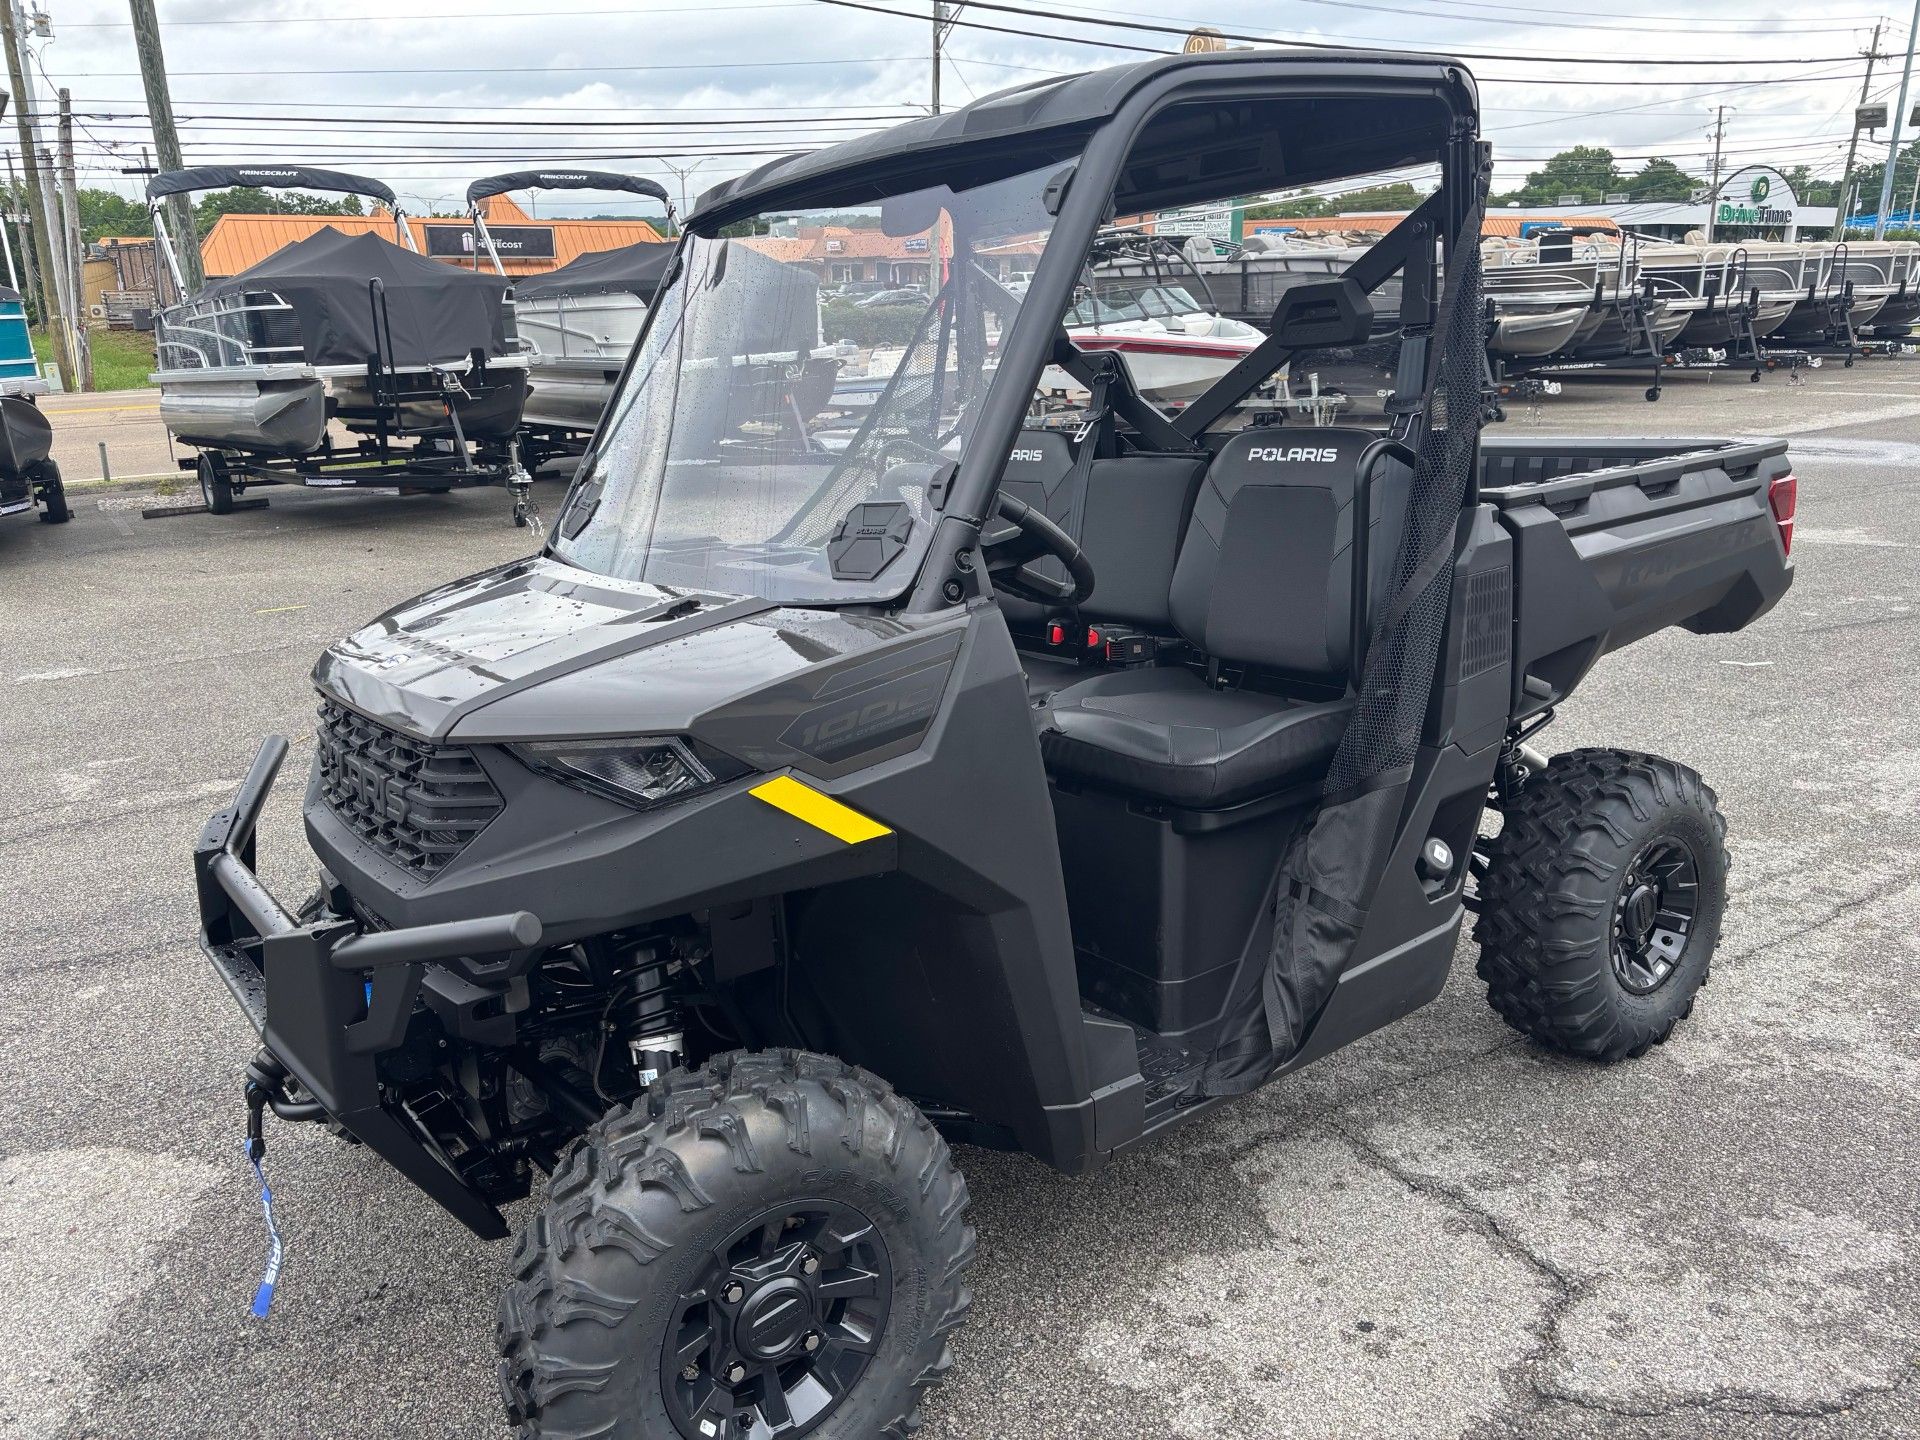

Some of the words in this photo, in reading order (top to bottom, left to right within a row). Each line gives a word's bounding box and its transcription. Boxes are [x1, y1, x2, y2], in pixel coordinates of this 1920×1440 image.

[1718, 203, 1792, 223] DriveTime
[1009, 449, 1043, 462] ARIS
[1247, 447, 1338, 462] POLARIS
[317, 724, 407, 824] POLARIS
[262, 1199, 283, 1287] POLARIS
